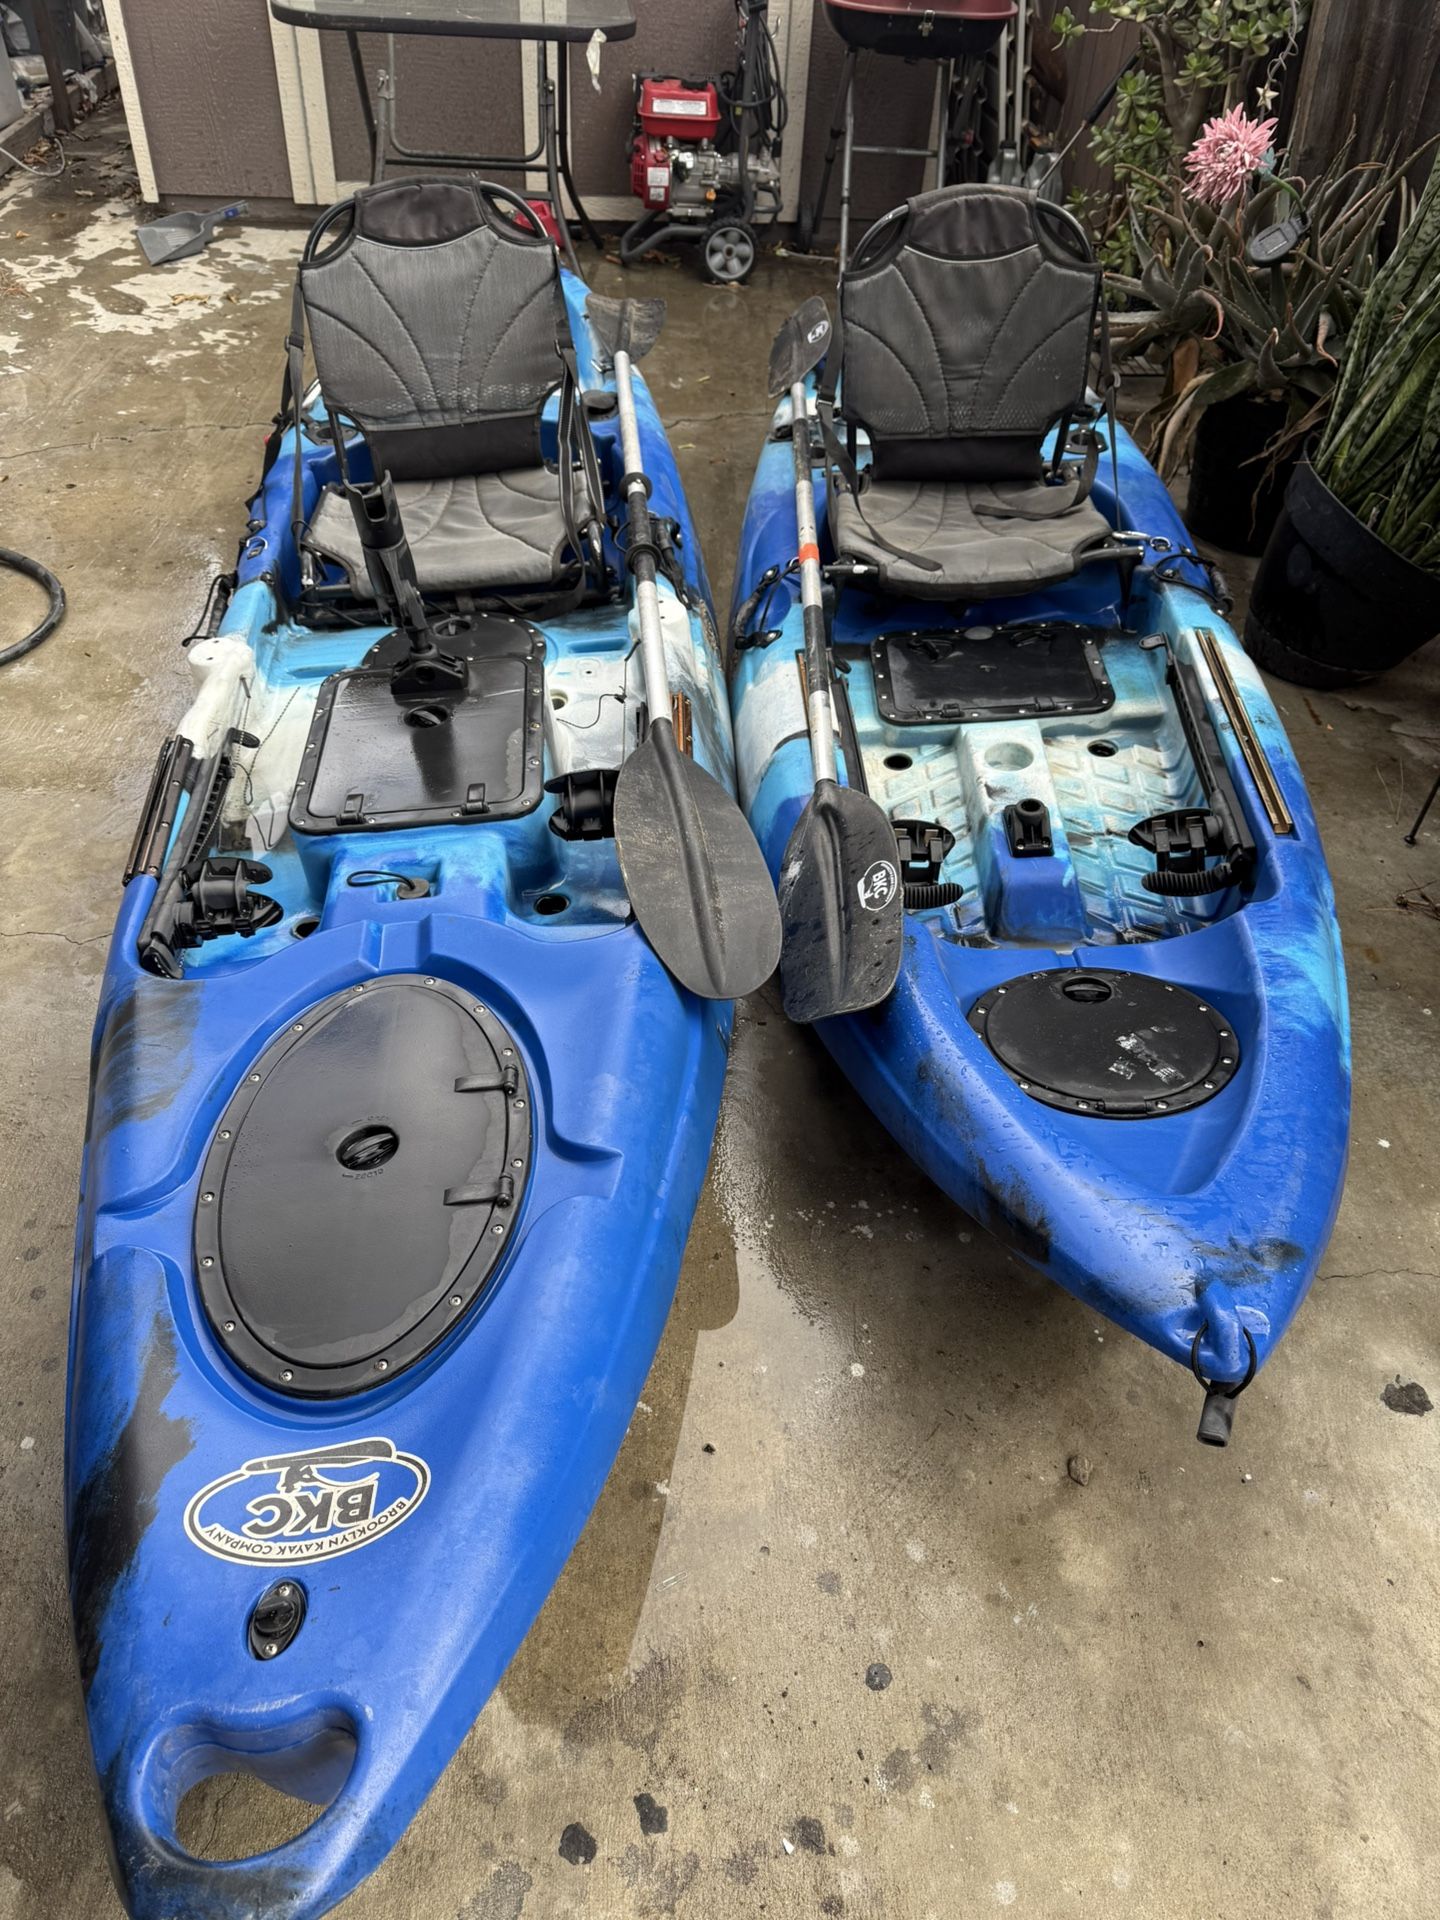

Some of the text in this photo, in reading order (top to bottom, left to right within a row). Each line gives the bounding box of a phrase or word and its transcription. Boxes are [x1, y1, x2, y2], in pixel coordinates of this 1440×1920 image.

[872, 869, 888, 899] BKC
[205, 1501, 407, 1556] BROOKLYN KAYAK COMPANY
[246, 1483, 375, 1536] BKC
